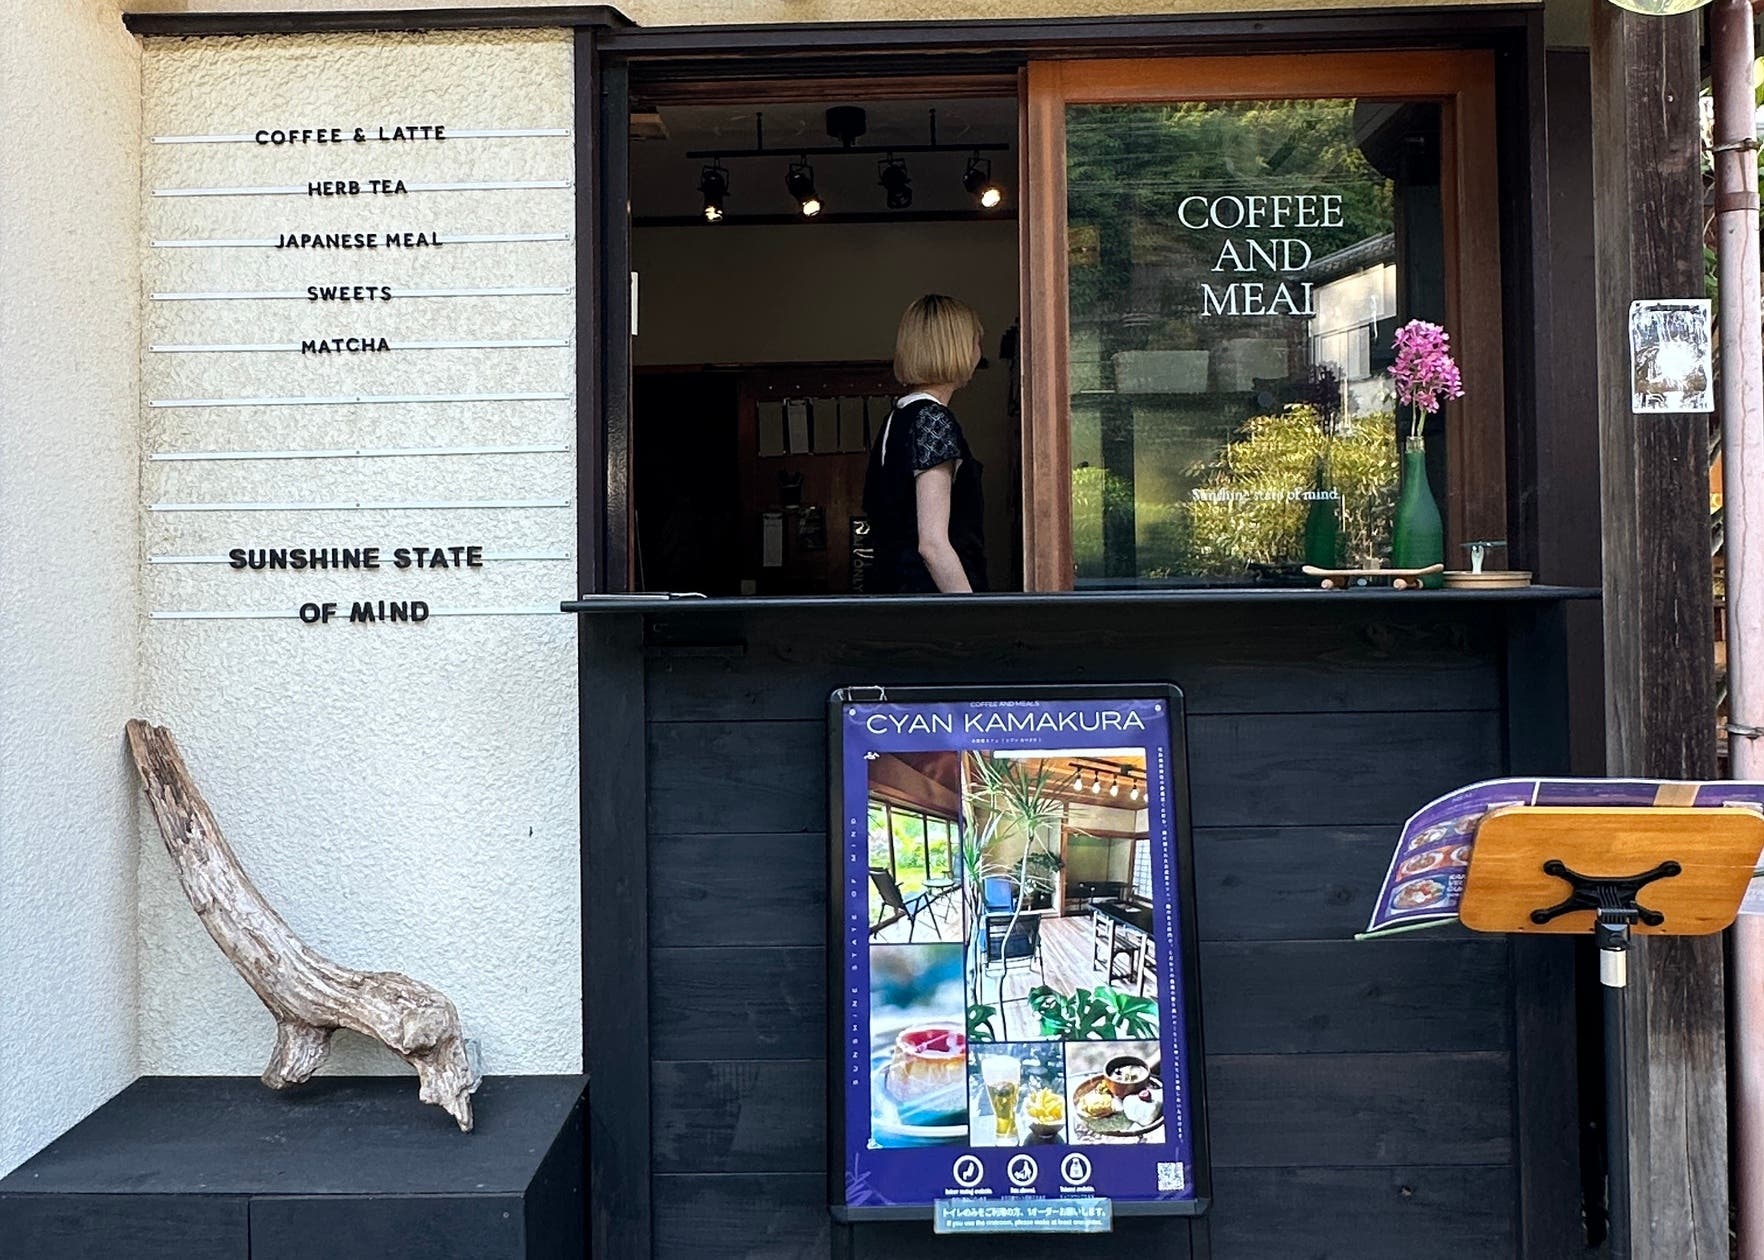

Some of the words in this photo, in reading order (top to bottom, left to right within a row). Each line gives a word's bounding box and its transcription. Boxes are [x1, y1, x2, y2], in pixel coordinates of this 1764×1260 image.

[255, 128, 343, 145] COFFEE
[353, 128, 367, 143] &
[379, 125, 446, 141] LATTE
[308, 181, 361, 197] HERB
[369, 179, 408, 195] TEA
[1178, 195, 1344, 229] COFFEE
[275, 234, 377, 250] JAPANESE
[386, 232, 443, 248] MEAL
[1211, 238, 1312, 272] AND
[307, 286, 392, 302] SWEETS
[1200, 282, 1317, 317] MEAL
[301, 338, 391, 355] MATCHA
[1287, 488, 1300, 502] of
[229, 548, 380, 569] SUNSHINE
[393, 546, 483, 568] STATE
[299, 602, 337, 623] OF
[350, 600, 429, 623] MIND
[866, 713, 953, 734] CYAN
[964, 711, 1145, 732] KAMAKURA
[850, 878, 858, 898] OF
[851, 987, 859, 1085] SUNSHINE
